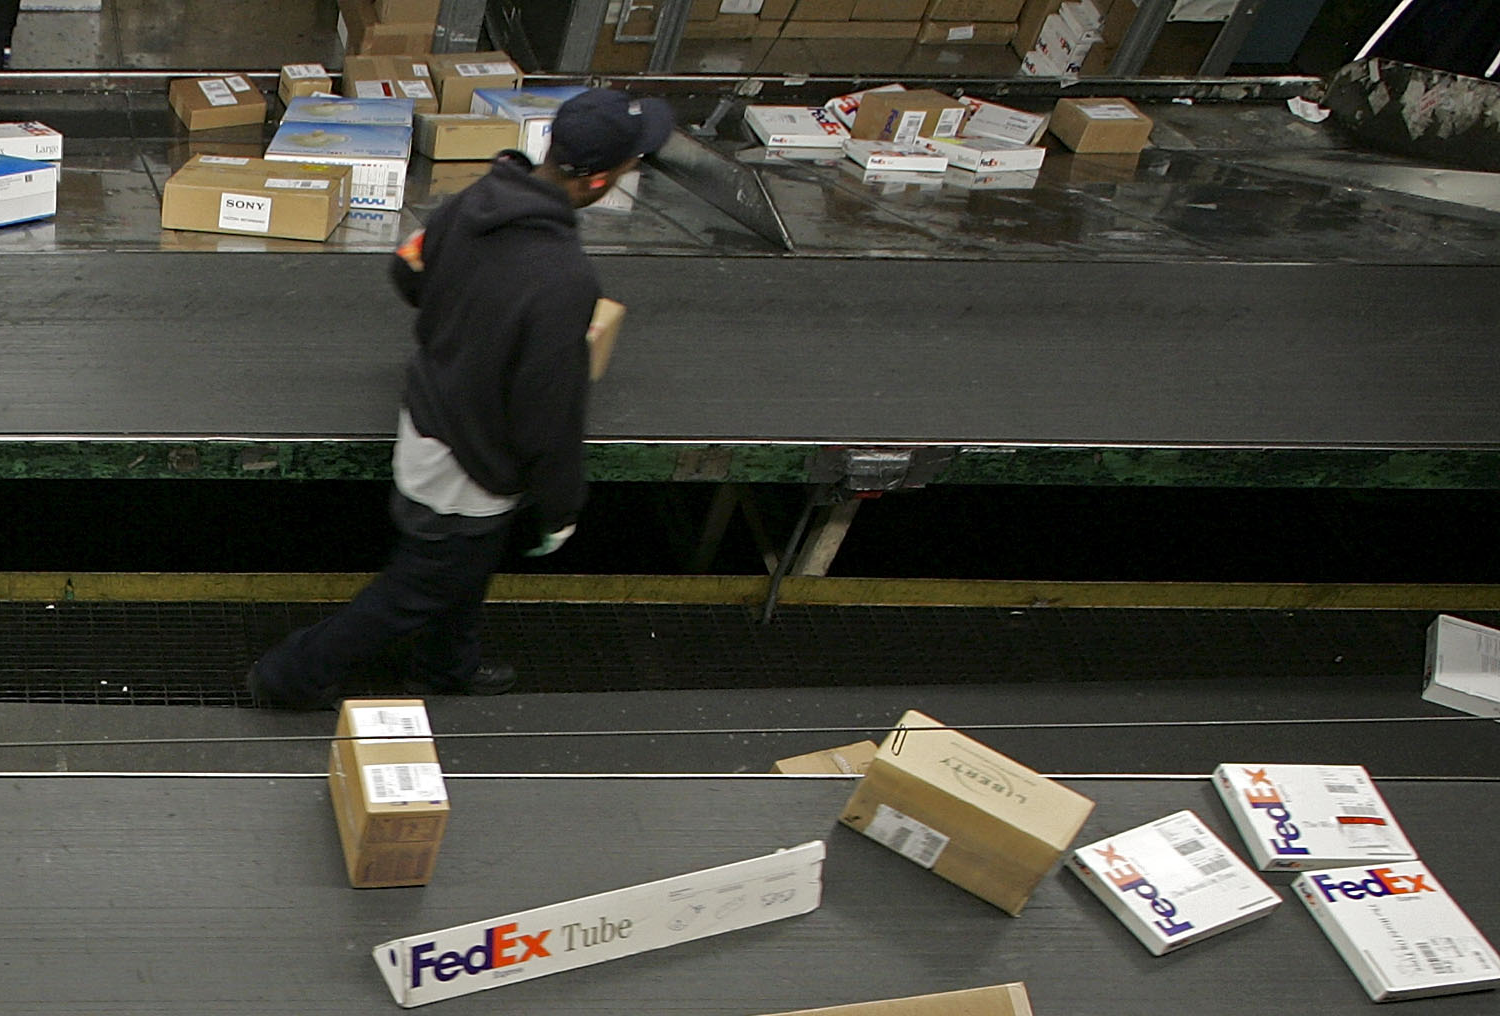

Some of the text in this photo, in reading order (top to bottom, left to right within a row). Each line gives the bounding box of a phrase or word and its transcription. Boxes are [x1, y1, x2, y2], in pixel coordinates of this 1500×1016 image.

[226, 199, 264, 210] SONY
[940, 757, 1027, 804] LIBERTY
[1244, 766, 1311, 856] FedEx
[1094, 842, 1193, 937] FedEx
[1313, 868, 1437, 902] FedEx
[411, 917, 633, 988] FedEx Tube
